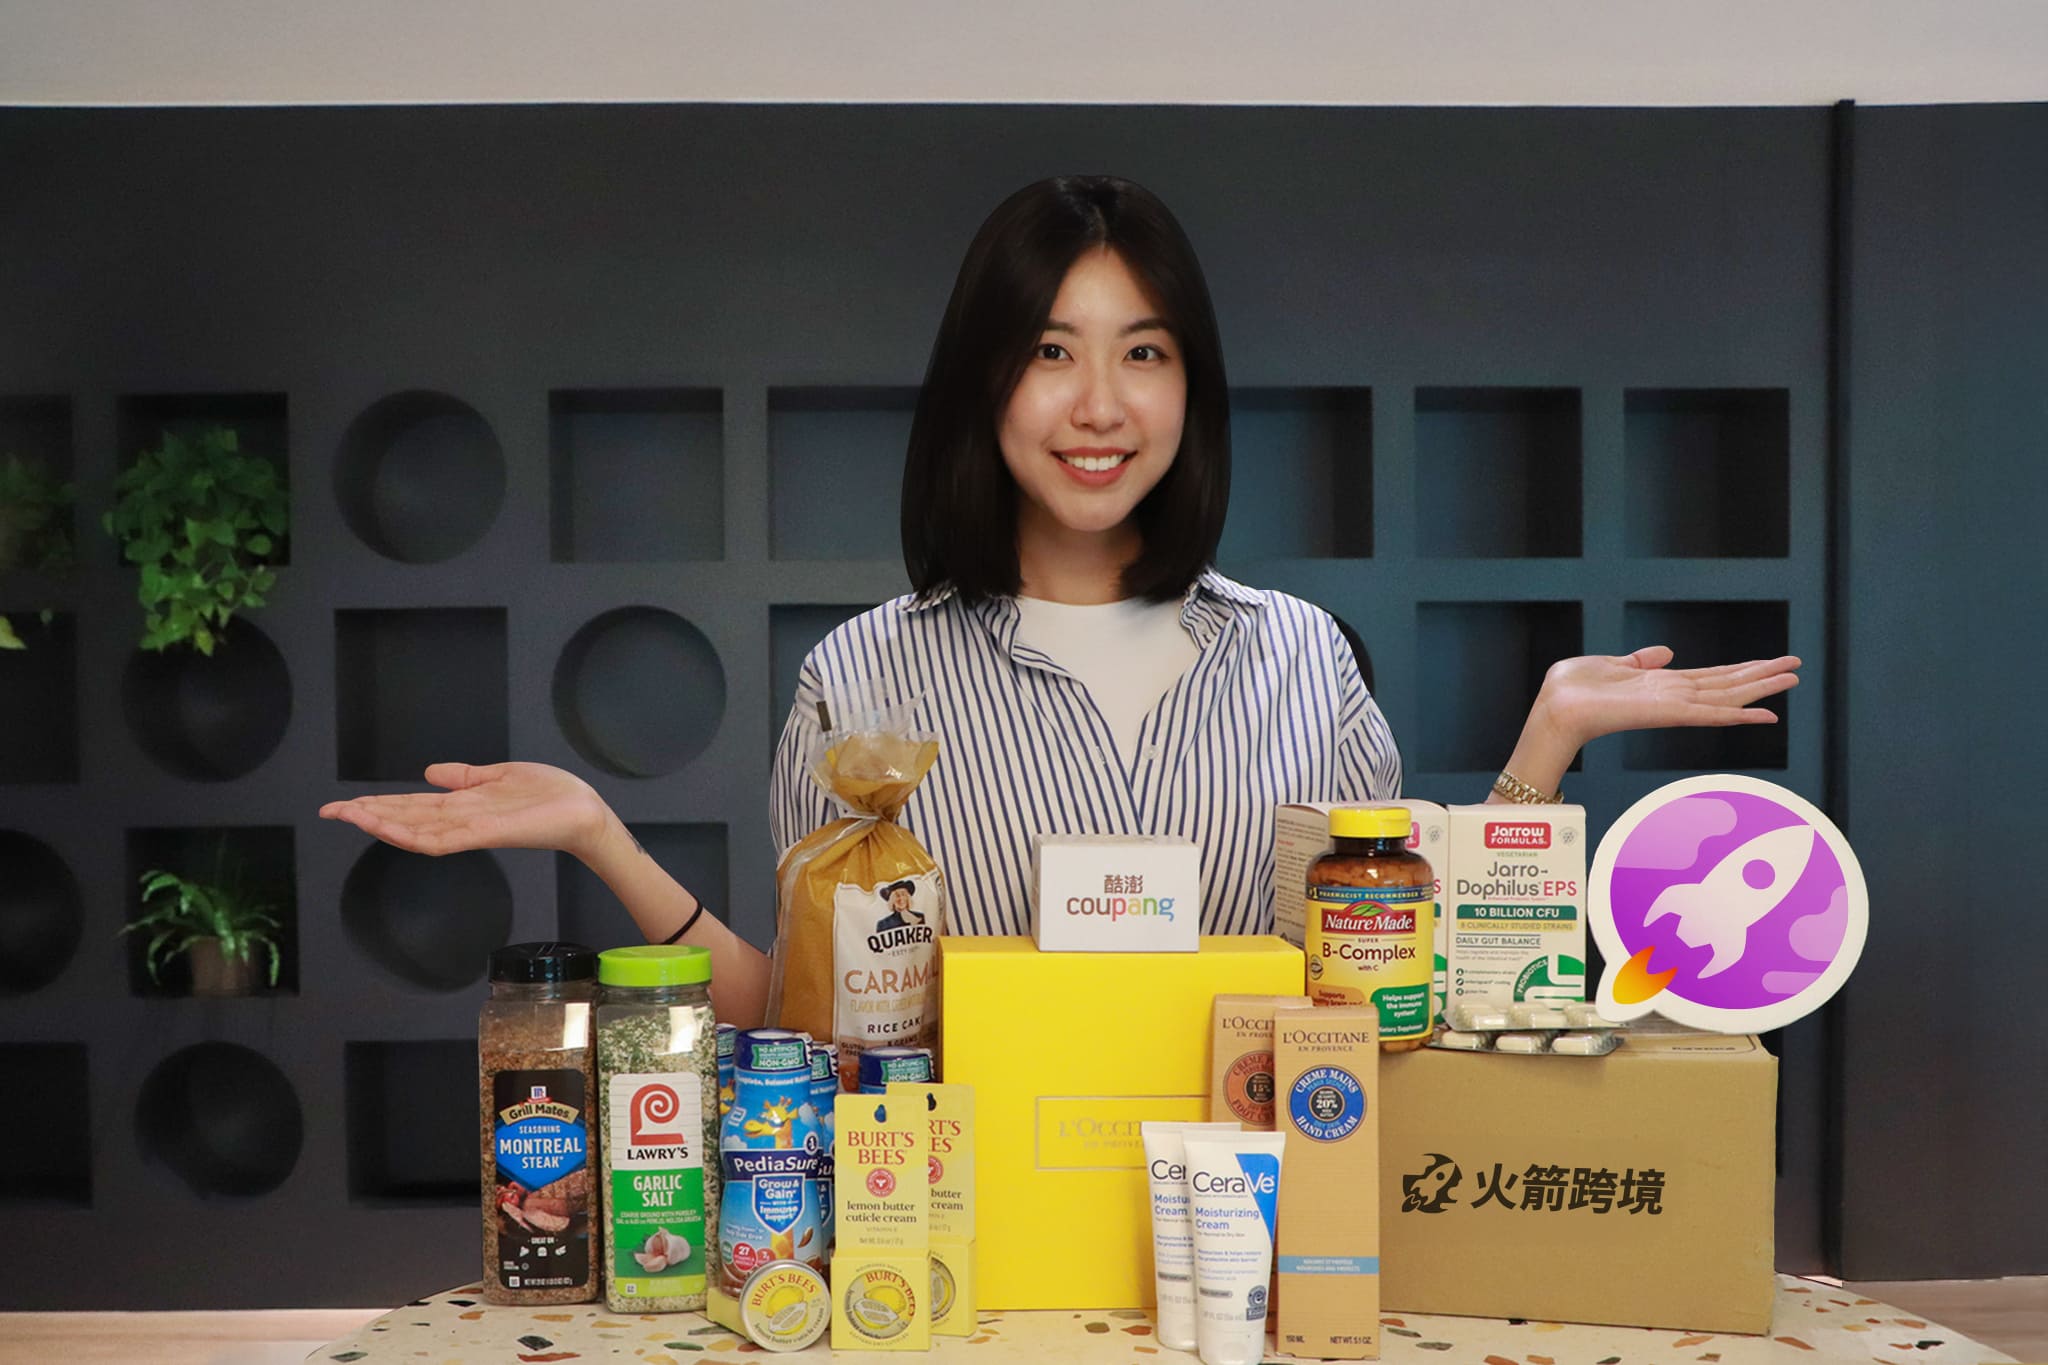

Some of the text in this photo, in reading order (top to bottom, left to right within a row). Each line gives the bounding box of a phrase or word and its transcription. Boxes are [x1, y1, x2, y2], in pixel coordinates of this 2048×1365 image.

[1491, 825, 1544, 837] Jarrow
[1487, 861, 1548, 878] Jarro-
[1104, 874, 1143, 894] 酷澎
[1457, 880, 1539, 900] Dophilus
[1543, 881, 1577, 896] EPS
[1066, 897, 1175, 922] coupang
[1474, 908, 1560, 917] 10 BILLION CFU
[1325, 914, 1373, 930] Nature
[1373, 914, 1413, 930] Made
[867, 926, 933, 953] QUAKER
[1456, 936, 1479, 944] DAILY
[1501, 937, 1541, 945] BALANCE
[1322, 942, 1416, 964] B-Complex
[844, 957, 939, 994] CARAML
[867, 1015, 924, 1033] RICE CAK
[1222, 1016, 1275, 1030] L'OCCIT
[1283, 1030, 1370, 1044] L'OCCITANE
[759, 1057, 800, 1067] NON-GMO
[1329, 1070, 1359, 1094] MAINS
[508, 1104, 570, 1119] Grill Mates
[1316, 1099, 1338, 1109] 20%
[519, 1125, 561, 1134] SEASONING
[928, 1120, 961, 1136] RT'S
[1059, 1117, 1142, 1137] L'OCCIT
[1296, 1115, 1358, 1139] HAND CREAM
[500, 1137, 582, 1155] MONTREAL
[847, 1131, 914, 1148] BURT'S
[928, 1137, 953, 1153] ES
[627, 1147, 689, 1160] LAWRY'S
[858, 1149, 906, 1165] BEES
[522, 1156, 560, 1169] STEAK
[734, 1156, 818, 1172] PediaSure
[633, 1174, 682, 1191] GARLIC
[759, 1179, 792, 1189] Grow
[1192, 1171, 1275, 1194] CeraVe
[1471, 1163, 1665, 1215] 火箭跨境
[642, 1191, 674, 1207] SALT
[765, 1189, 793, 1199] Gain
[931, 1188, 962, 1199] butter
[1154, 1194, 1190, 1204] Moistu
[847, 1201, 915, 1211] lemon butter
[1155, 1206, 1188, 1216] Cream
[1195, 1208, 1260, 1219] Moisturizing
[845, 1213, 882, 1222] cuticle
[1196, 1219, 1230, 1230] Cream
[738, 1246, 751, 1255] 27
[865, 1271, 907, 1289] BURT'S
[752, 1273, 816, 1307] BURT'S BEES
